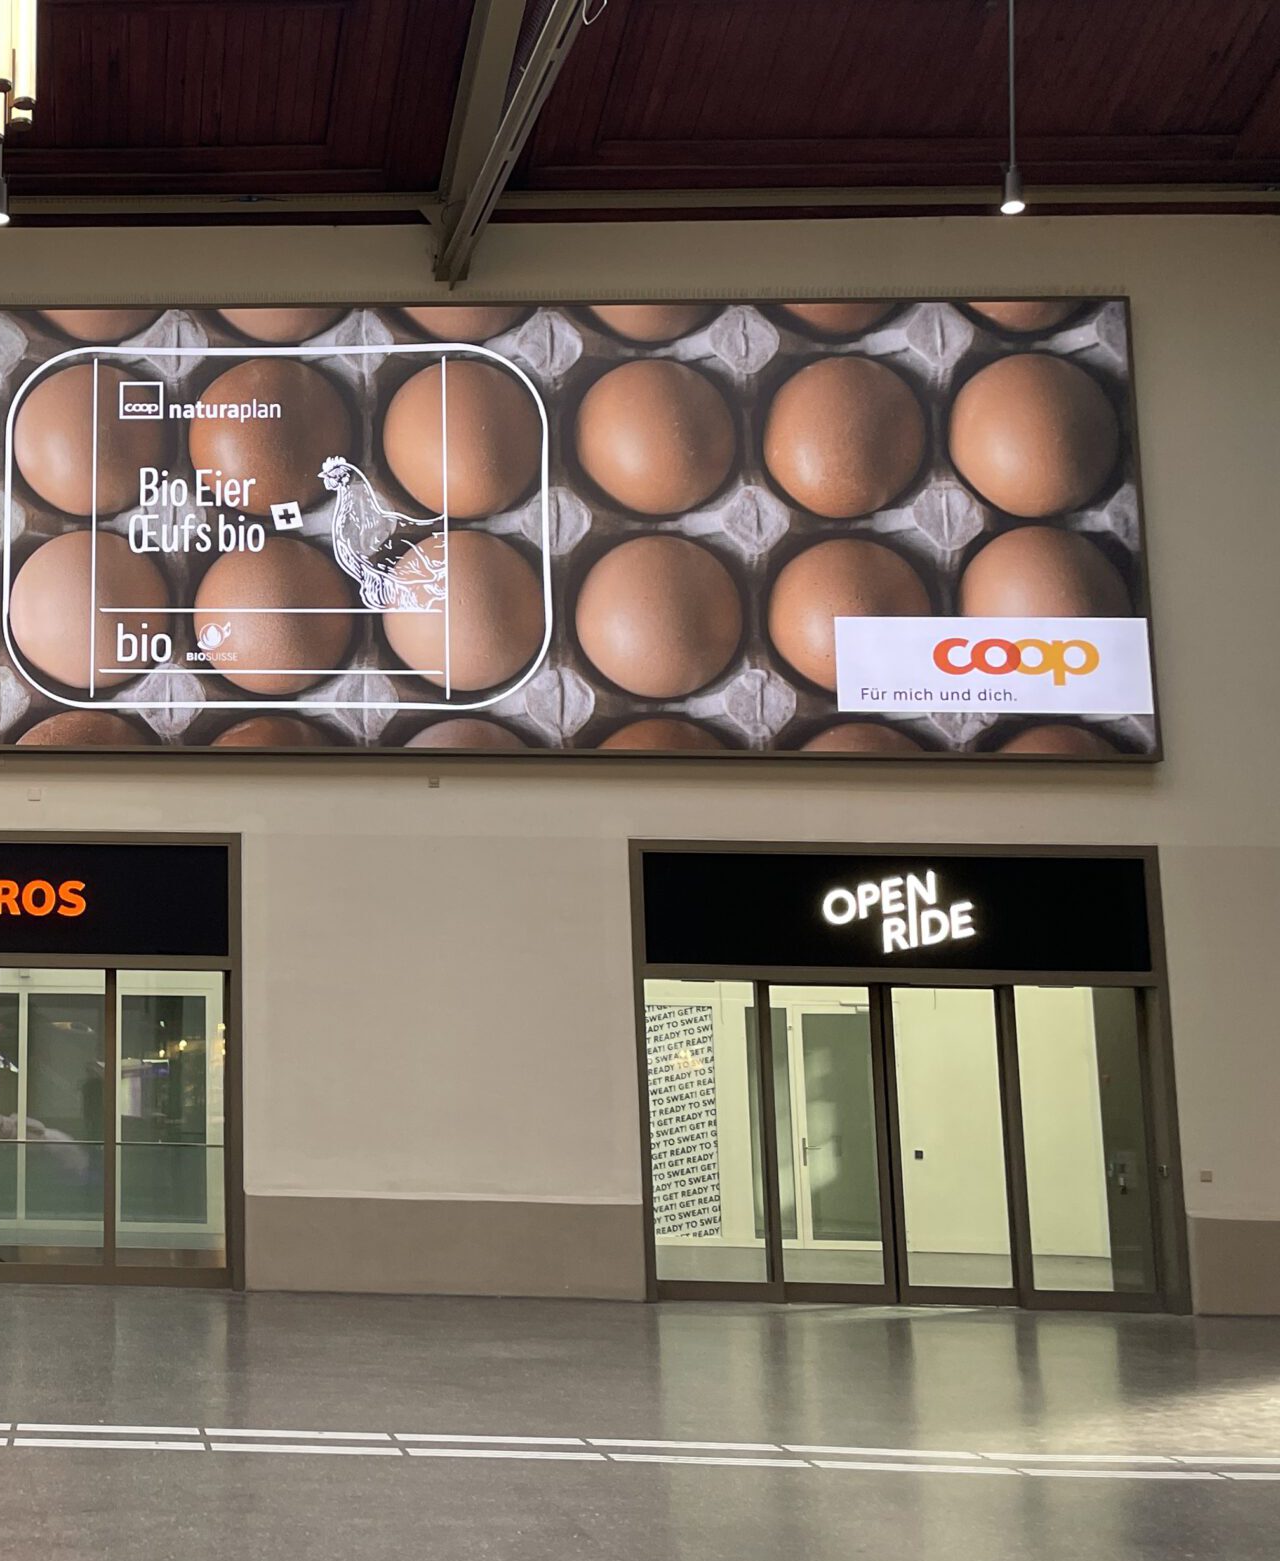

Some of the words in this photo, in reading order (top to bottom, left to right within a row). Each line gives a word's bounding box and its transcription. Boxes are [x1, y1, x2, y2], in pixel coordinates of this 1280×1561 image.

[124, 402, 158, 415] coop
[169, 399, 281, 423] naturaplan
[139, 467, 188, 507] Bio
[196, 469, 256, 507] Eier
[128, 515, 212, 553] Œufs
[218, 515, 265, 552] bio
[116, 623, 172, 662] bio
[933, 637, 1100, 686] coop
[861, 687, 887, 702] Für
[894, 688, 933, 701] mich
[940, 689, 971, 702] und
[978, 689, 1018, 702] dich.
[822, 870, 936, 926] OPEN
[883, 901, 976, 953] RIDE
[678, 1008, 693, 1016] GET
[667, 1021, 678, 1029] TO
[654, 1031, 680, 1043] READY
[668, 1041, 683, 1050] GET
[686, 1035, 713, 1047] READY
[665, 1071, 691, 1082] READY
[694, 1069, 705, 1077] TO
[678, 1081, 694, 1090] GET
[652, 1098, 664, 1106] TO
[666, 1091, 697, 1103] SWEAT!
[700, 1088, 715, 1096] GET
[659, 1104, 686, 1116] READY
[657, 1118, 673, 1126] GET
[676, 1112, 702, 1123] READY
[656, 1125, 686, 1138] SWEAT!
[689, 1122, 705, 1130] GET
[663, 1139, 675, 1147] TO
[677, 1132, 708, 1144] SWEAT!
[670, 1145, 697, 1157] READY
[700, 1142, 711, 1150] TO
[668, 1159, 684, 1167] GET
[687, 1152, 714, 1164] READY
[653, 1173, 665, 1181] TO
[667, 1166, 698, 1178] SWEAT!
[701, 1163, 716, 1172] GET
[674, 1180, 686, 1188] TO
[663, 1192, 679, 1201] GET
[681, 1186, 708, 1197] READY
[679, 1200, 695, 1208] GET
[665, 1214, 676, 1222] TO
[678, 1207, 709, 1219] SWEAT!
[656, 1224, 683, 1235] READY
[685, 1221, 697, 1229] TO
